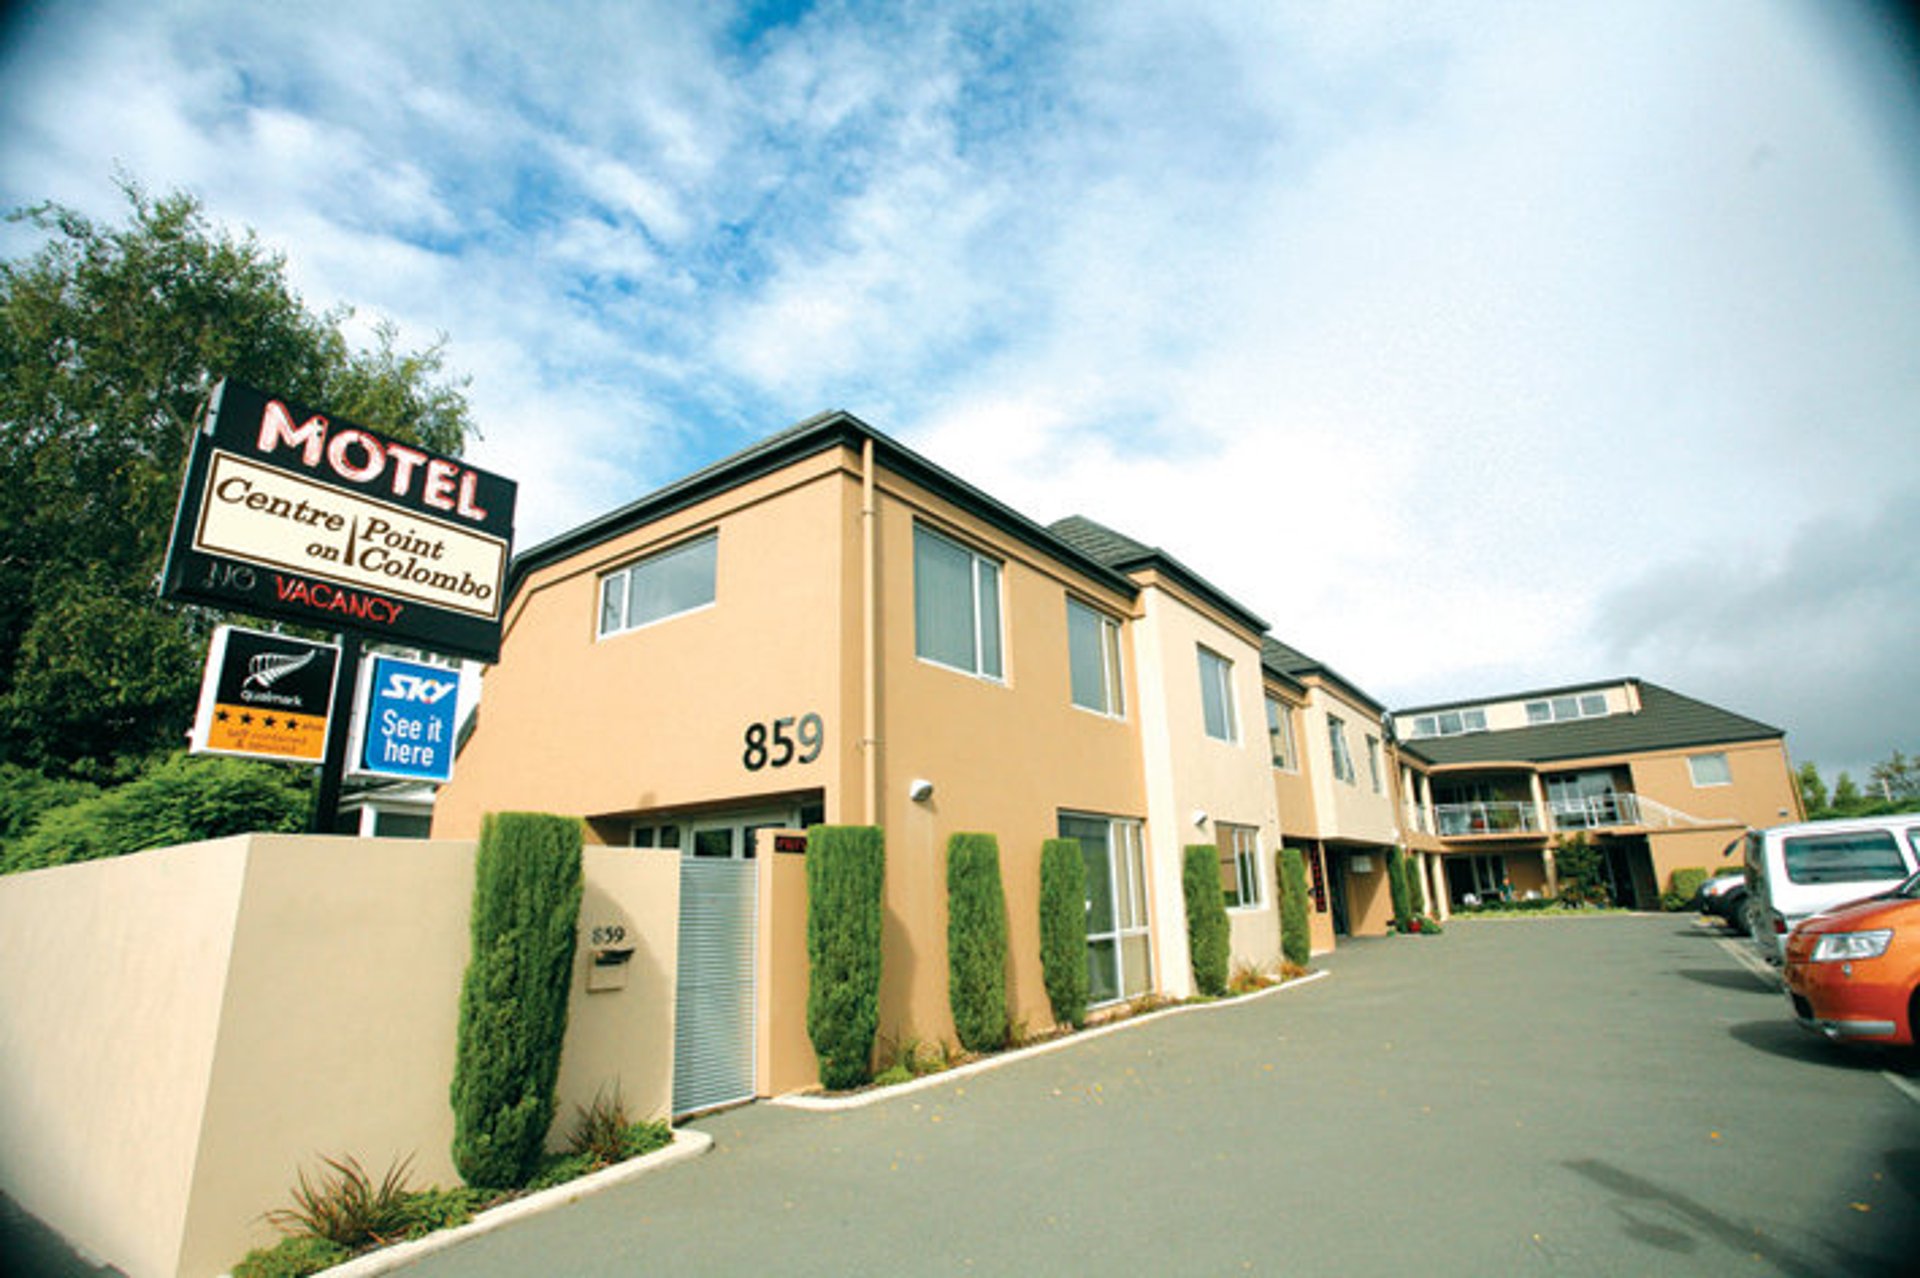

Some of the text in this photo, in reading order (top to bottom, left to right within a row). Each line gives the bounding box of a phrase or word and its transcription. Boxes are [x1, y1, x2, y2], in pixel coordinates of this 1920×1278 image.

[256, 400, 488, 521] MOTEL
[216, 476, 445, 561] Centre Point
[203, 562, 404, 625] NO VACANCY
[305, 541, 492, 601] on Colombo
[381, 673, 455, 704] SKY
[381, 709, 442, 743] See it
[384, 739, 434, 767] here
[743, 713, 824, 771] 859
[592, 926, 626, 945] 859
